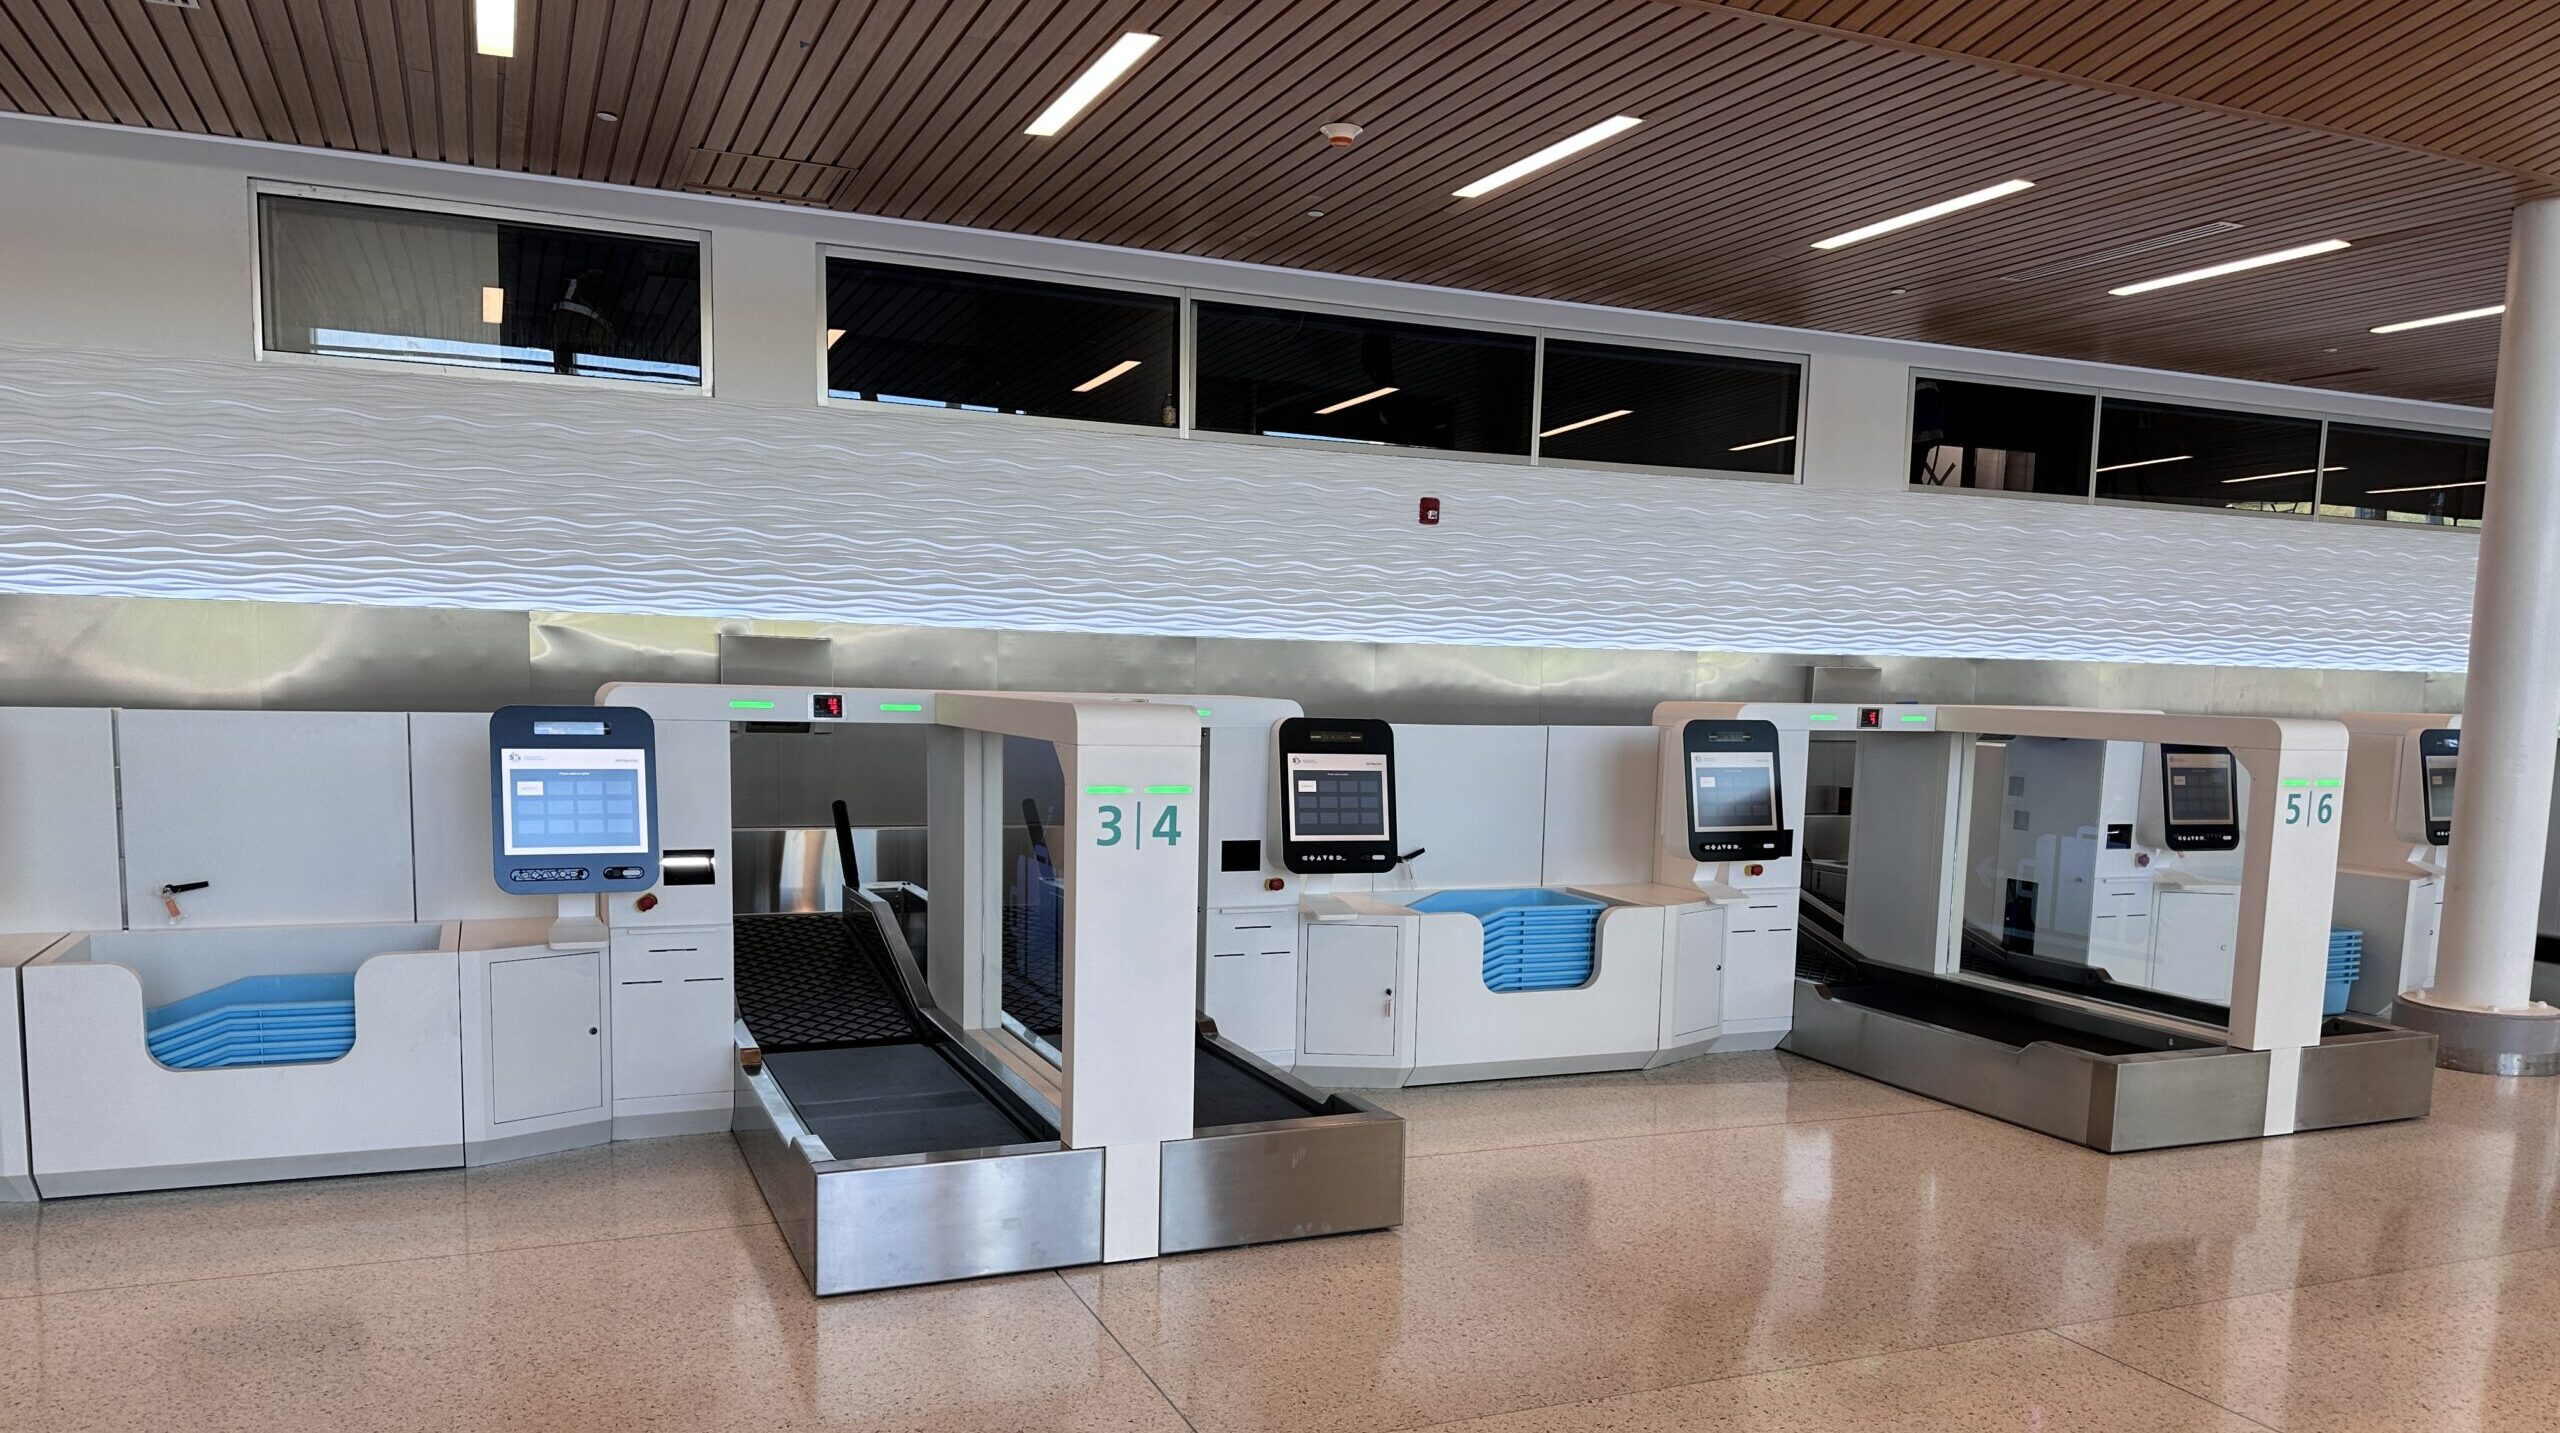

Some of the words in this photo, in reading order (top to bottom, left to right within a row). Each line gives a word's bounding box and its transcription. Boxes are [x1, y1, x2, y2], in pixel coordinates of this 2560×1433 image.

[1096, 805, 1122, 846] 3
[1152, 805, 1181, 846] 4
[2285, 793, 2301, 824] 5
[2318, 793, 2333, 824] 6
